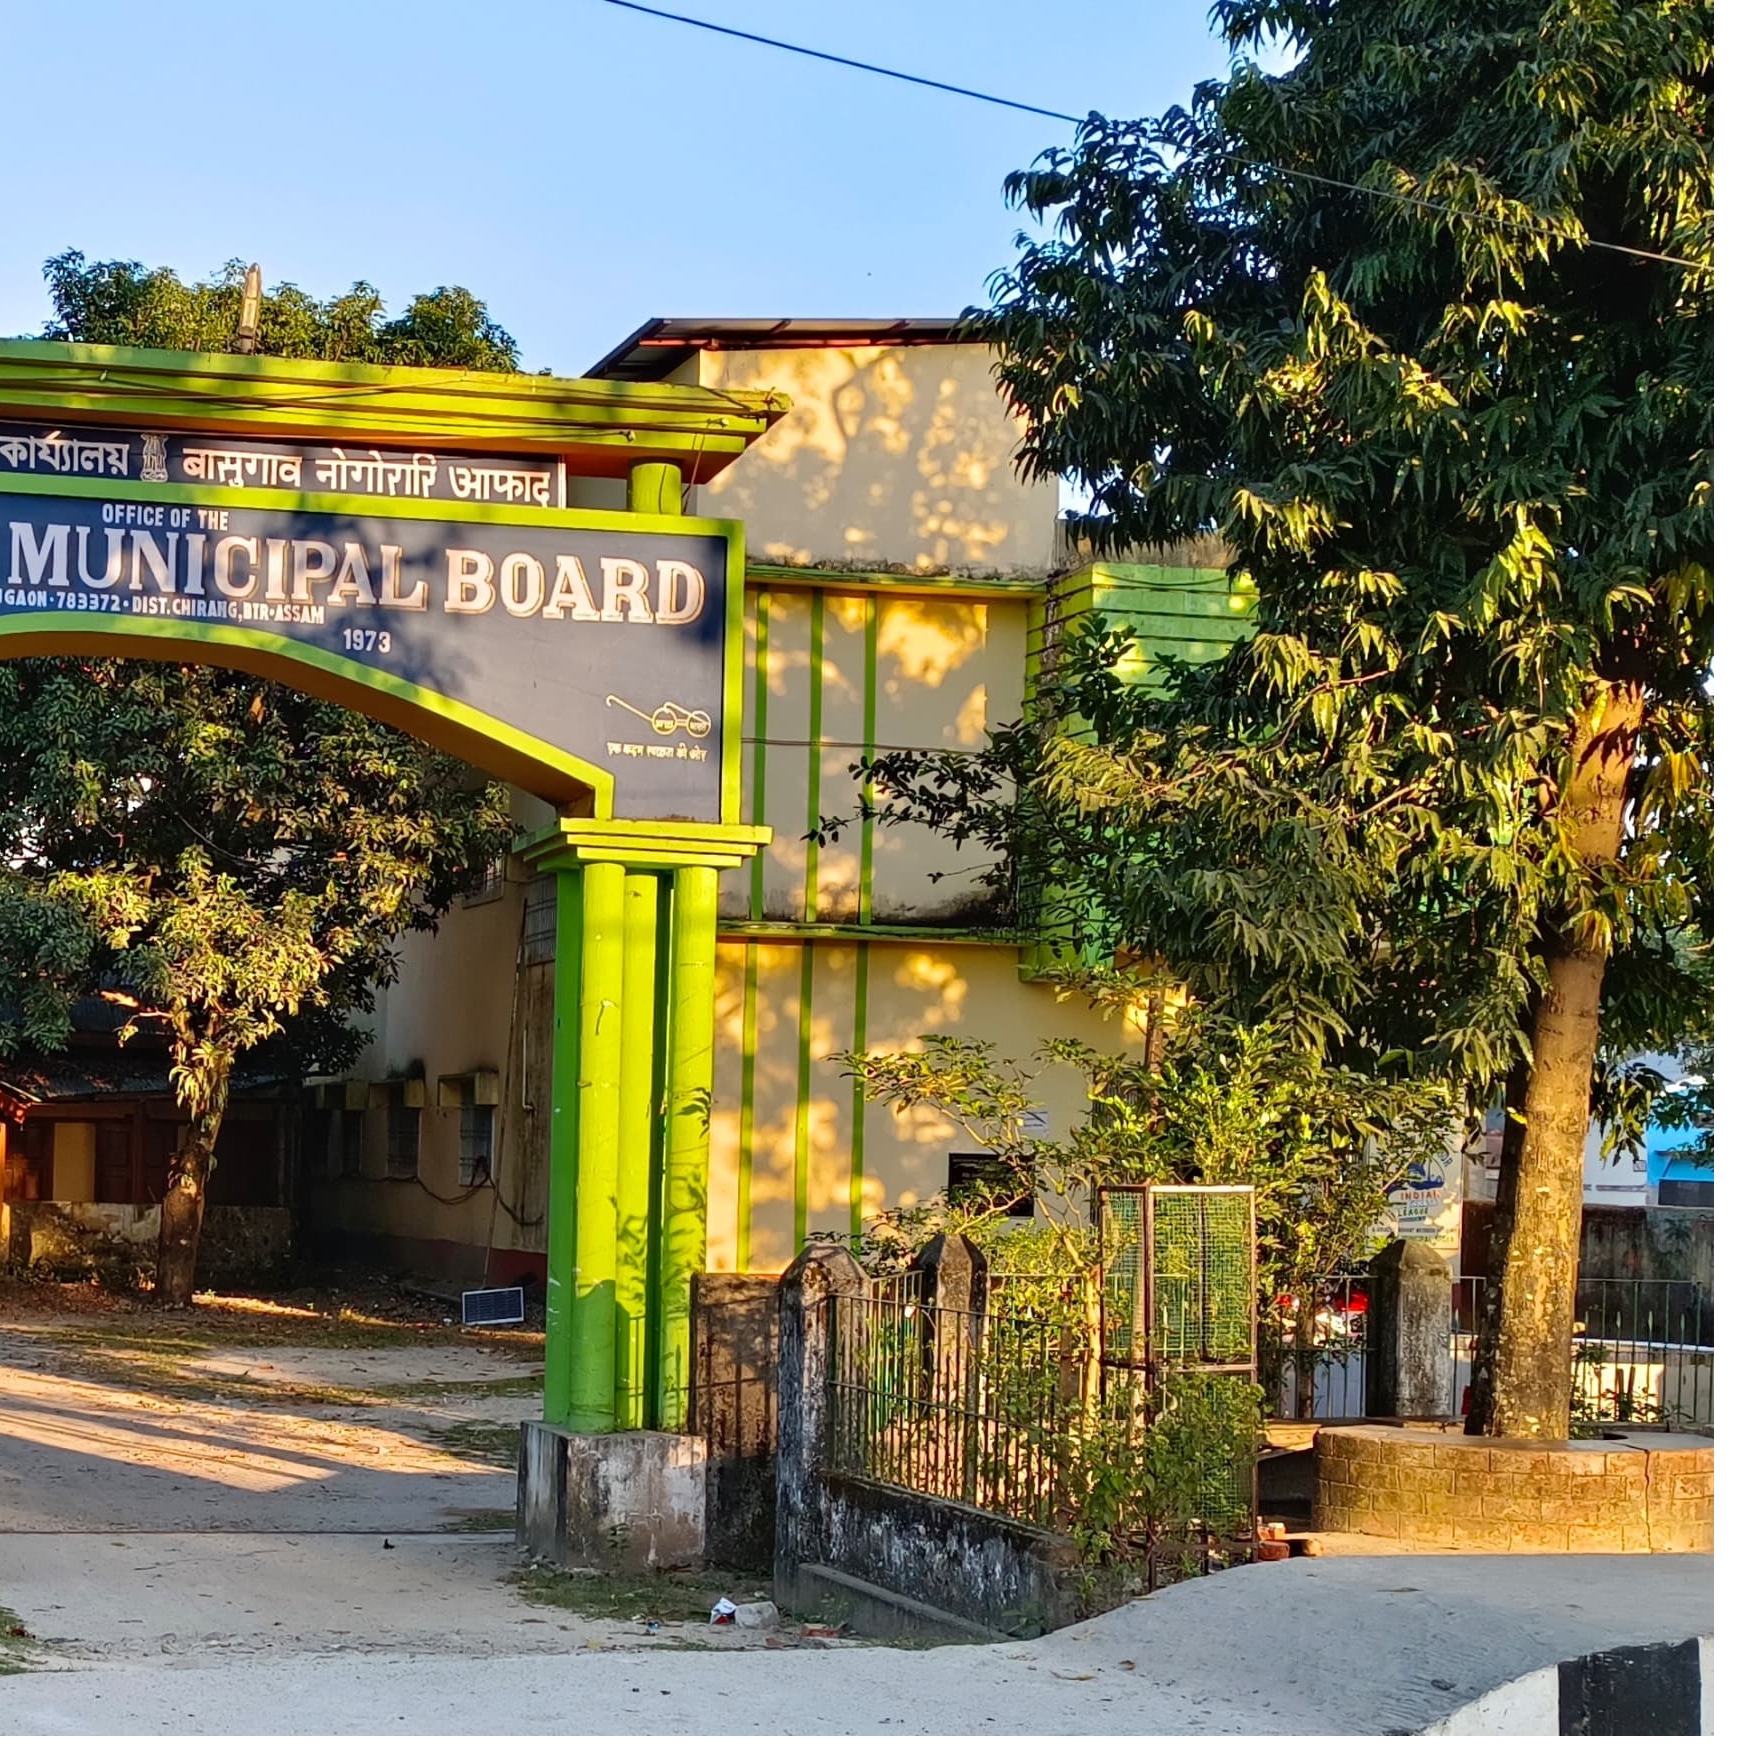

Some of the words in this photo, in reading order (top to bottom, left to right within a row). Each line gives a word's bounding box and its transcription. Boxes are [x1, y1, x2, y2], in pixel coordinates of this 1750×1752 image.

[101, 503, 164, 526] OFFICE
[170, 508, 191, 528] OF
[198, 510, 229, 531] THE
[7, 519, 428, 612] MUNICIPAL
[443, 547, 706, 626] BOARD
[342, 628, 392, 653] 1973
